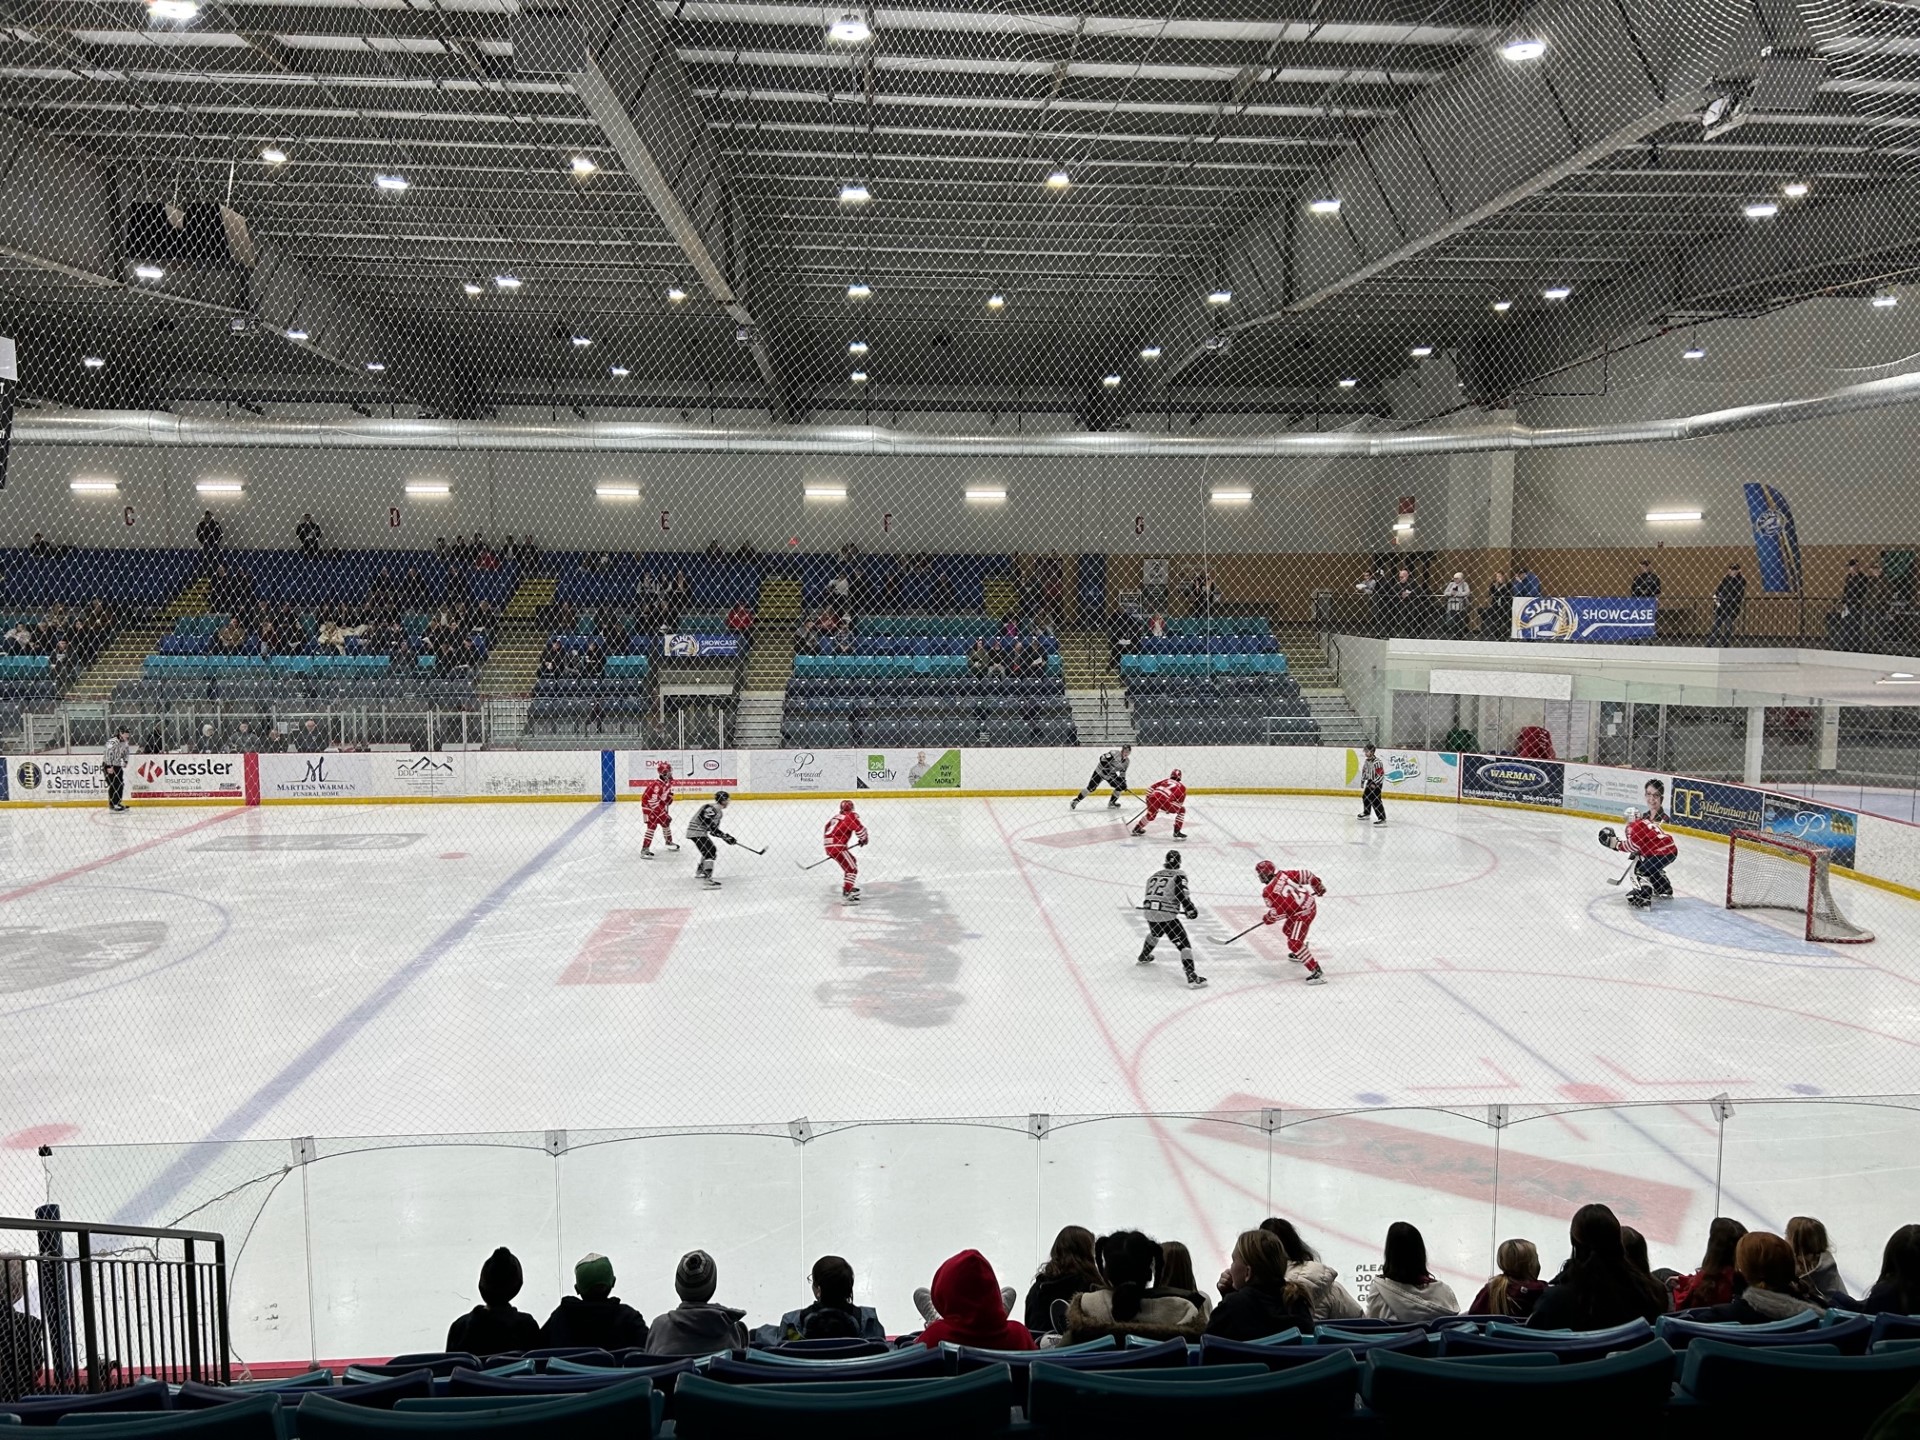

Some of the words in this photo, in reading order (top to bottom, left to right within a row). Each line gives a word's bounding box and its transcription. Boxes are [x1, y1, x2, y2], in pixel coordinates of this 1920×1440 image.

[124, 506, 135, 526] C
[389, 507, 401, 527] D
[661, 511, 670, 530] E
[1525, 599, 1559, 620] SJHL
[1582, 609, 1654, 621] SHOWCASE
[701, 639, 737, 647] SHOWCASE
[43, 762, 80, 775] CLARK'S
[82, 762, 104, 775] SUPP
[164, 758, 233, 775] Kessler
[867, 768, 897, 780] realty
[1490, 769, 1537, 782] WARMAN
[47, 780, 53, 789] &
[55, 776, 90, 789] SERVICE
[318, 783, 356, 791] WARMAN
[1146, 877, 1169, 896] 22
[1355, 1264, 1384, 1272] PLEA
